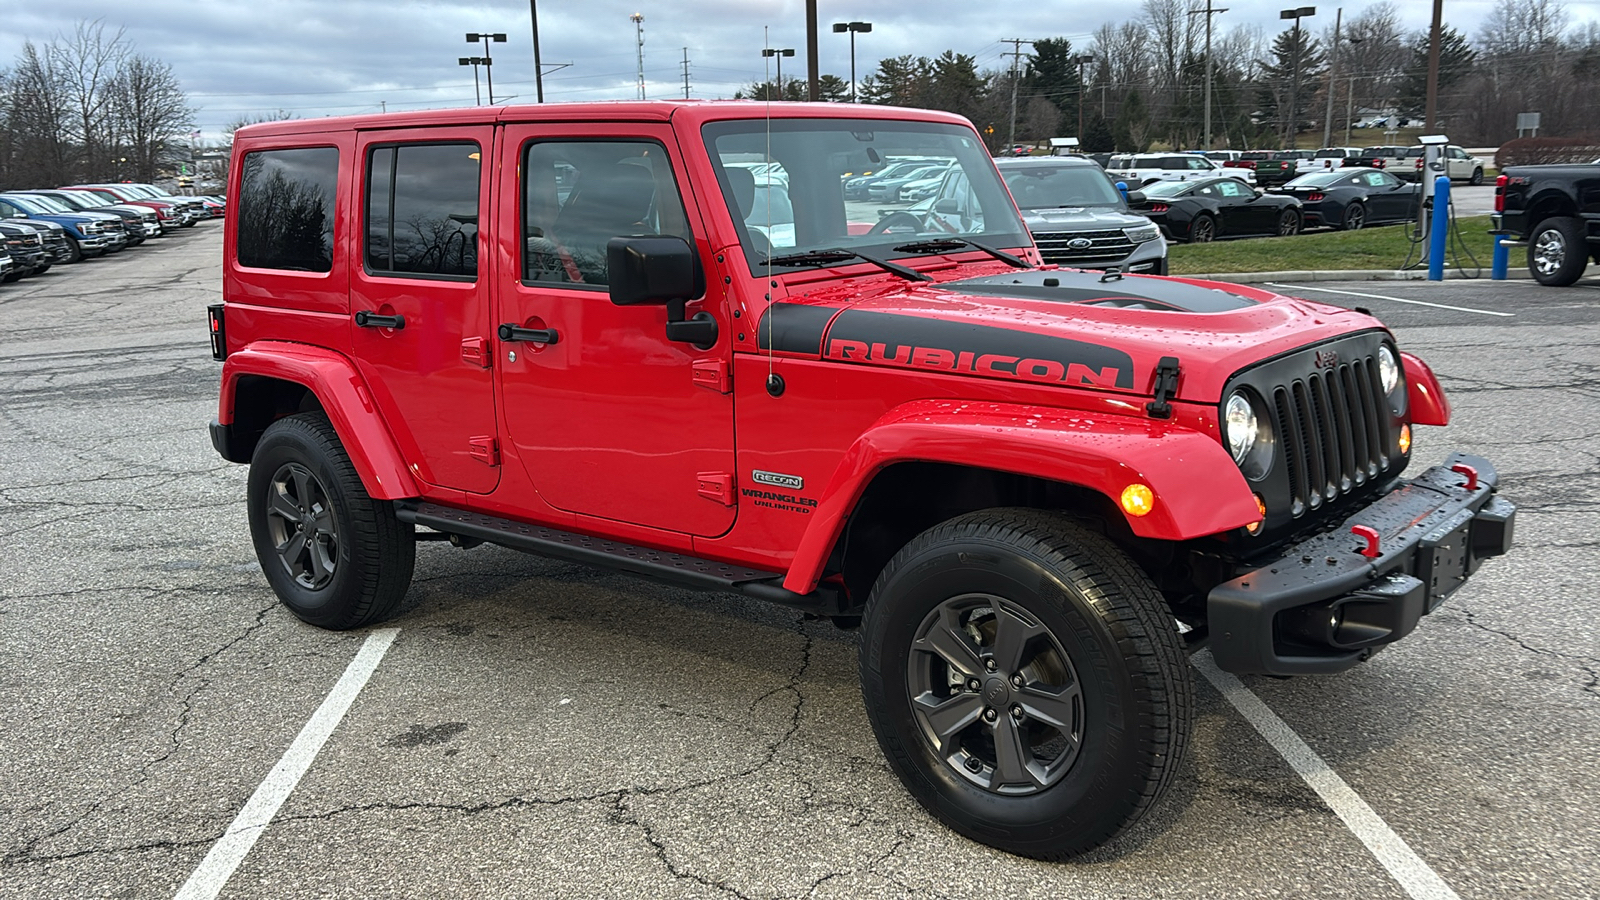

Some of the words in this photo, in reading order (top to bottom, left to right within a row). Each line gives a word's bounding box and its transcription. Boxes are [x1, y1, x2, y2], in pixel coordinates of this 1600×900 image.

[828, 339, 1119, 388] RUBICON
[1314, 350, 1338, 369] Jeep
[755, 473, 799, 486] RECON
[741, 488, 818, 508] WRANGLER
[754, 500, 810, 514] UNLIMITED
